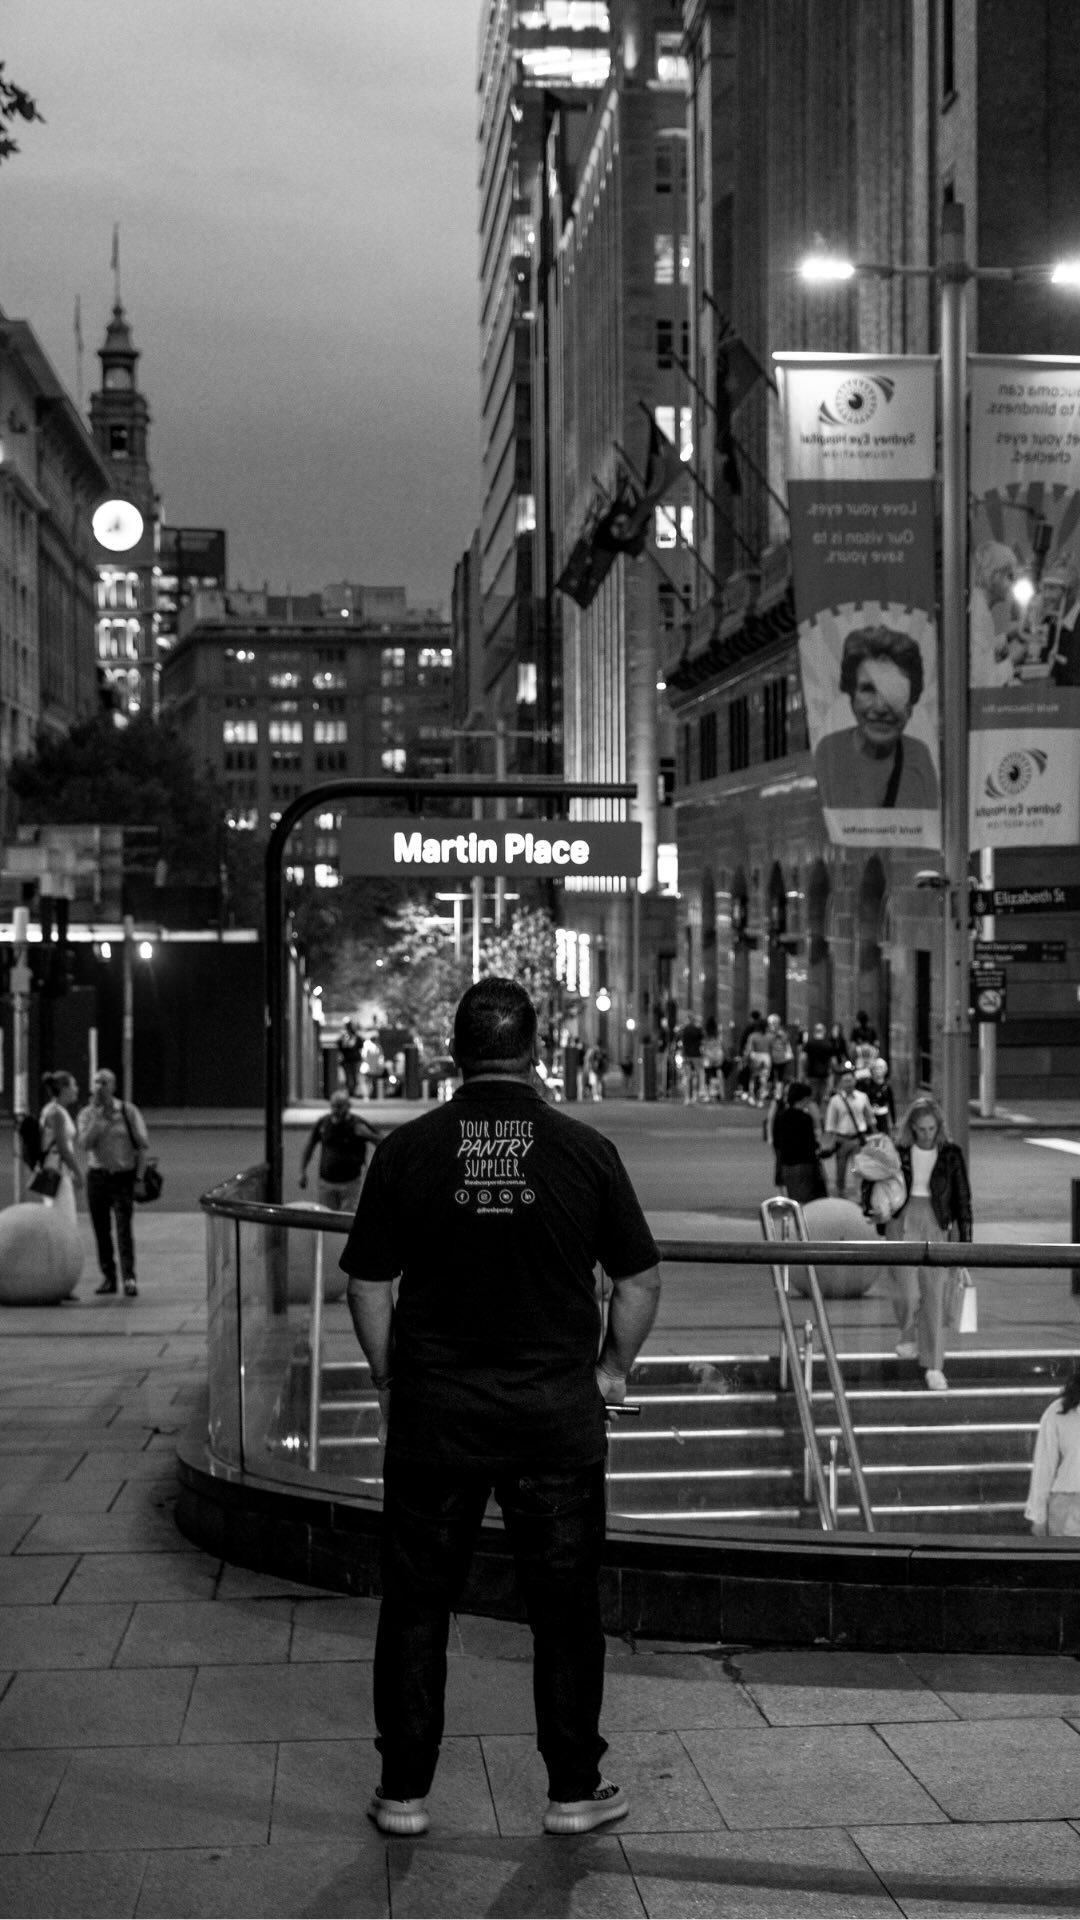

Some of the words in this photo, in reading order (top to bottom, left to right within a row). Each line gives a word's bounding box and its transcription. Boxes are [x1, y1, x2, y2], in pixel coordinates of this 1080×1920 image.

[393, 832, 498, 863] Martin
[504, 832, 590, 864] Place
[994, 889, 1052, 906] Elizabeth
[1052, 887, 1065, 903] St
[459, 1119, 490, 1138] YOUR
[495, 1119, 534, 1138] OFFICE
[456, 1138, 535, 1158] PANTRY
[464, 1158, 525, 1177] SUPPLIER.
